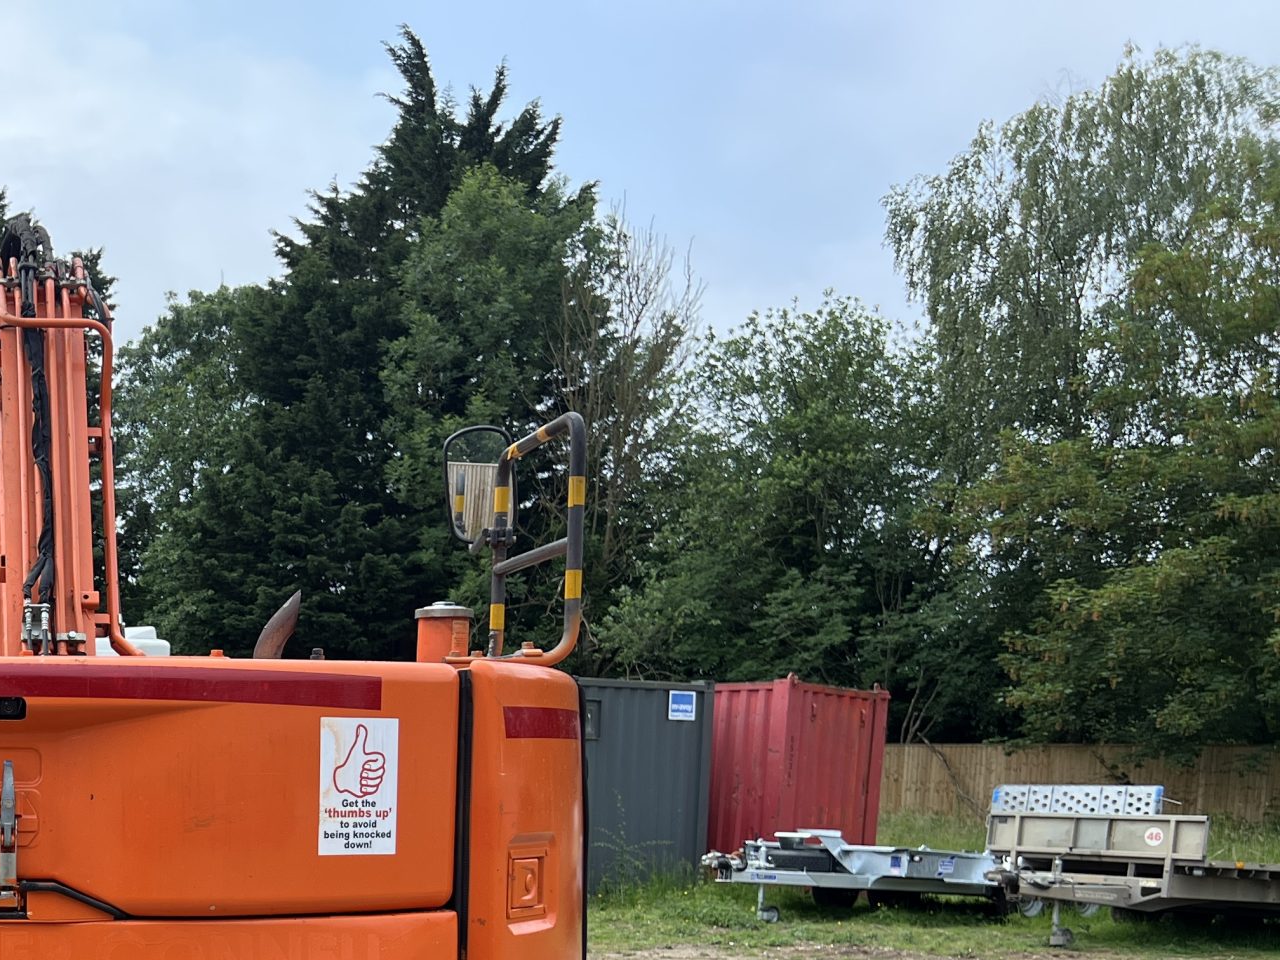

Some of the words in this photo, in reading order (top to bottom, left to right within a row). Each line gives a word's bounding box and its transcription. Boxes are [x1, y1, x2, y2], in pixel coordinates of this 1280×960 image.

[341, 799, 358, 808] Get
[361, 799, 376, 808] the
[340, 820, 350, 829] to
[352, 820, 377, 829] avoid
[323, 831, 350, 840] being
[353, 830, 392, 839] knocked
[1146, 831, 1162, 842] 46
[344, 840, 372, 849] down!
